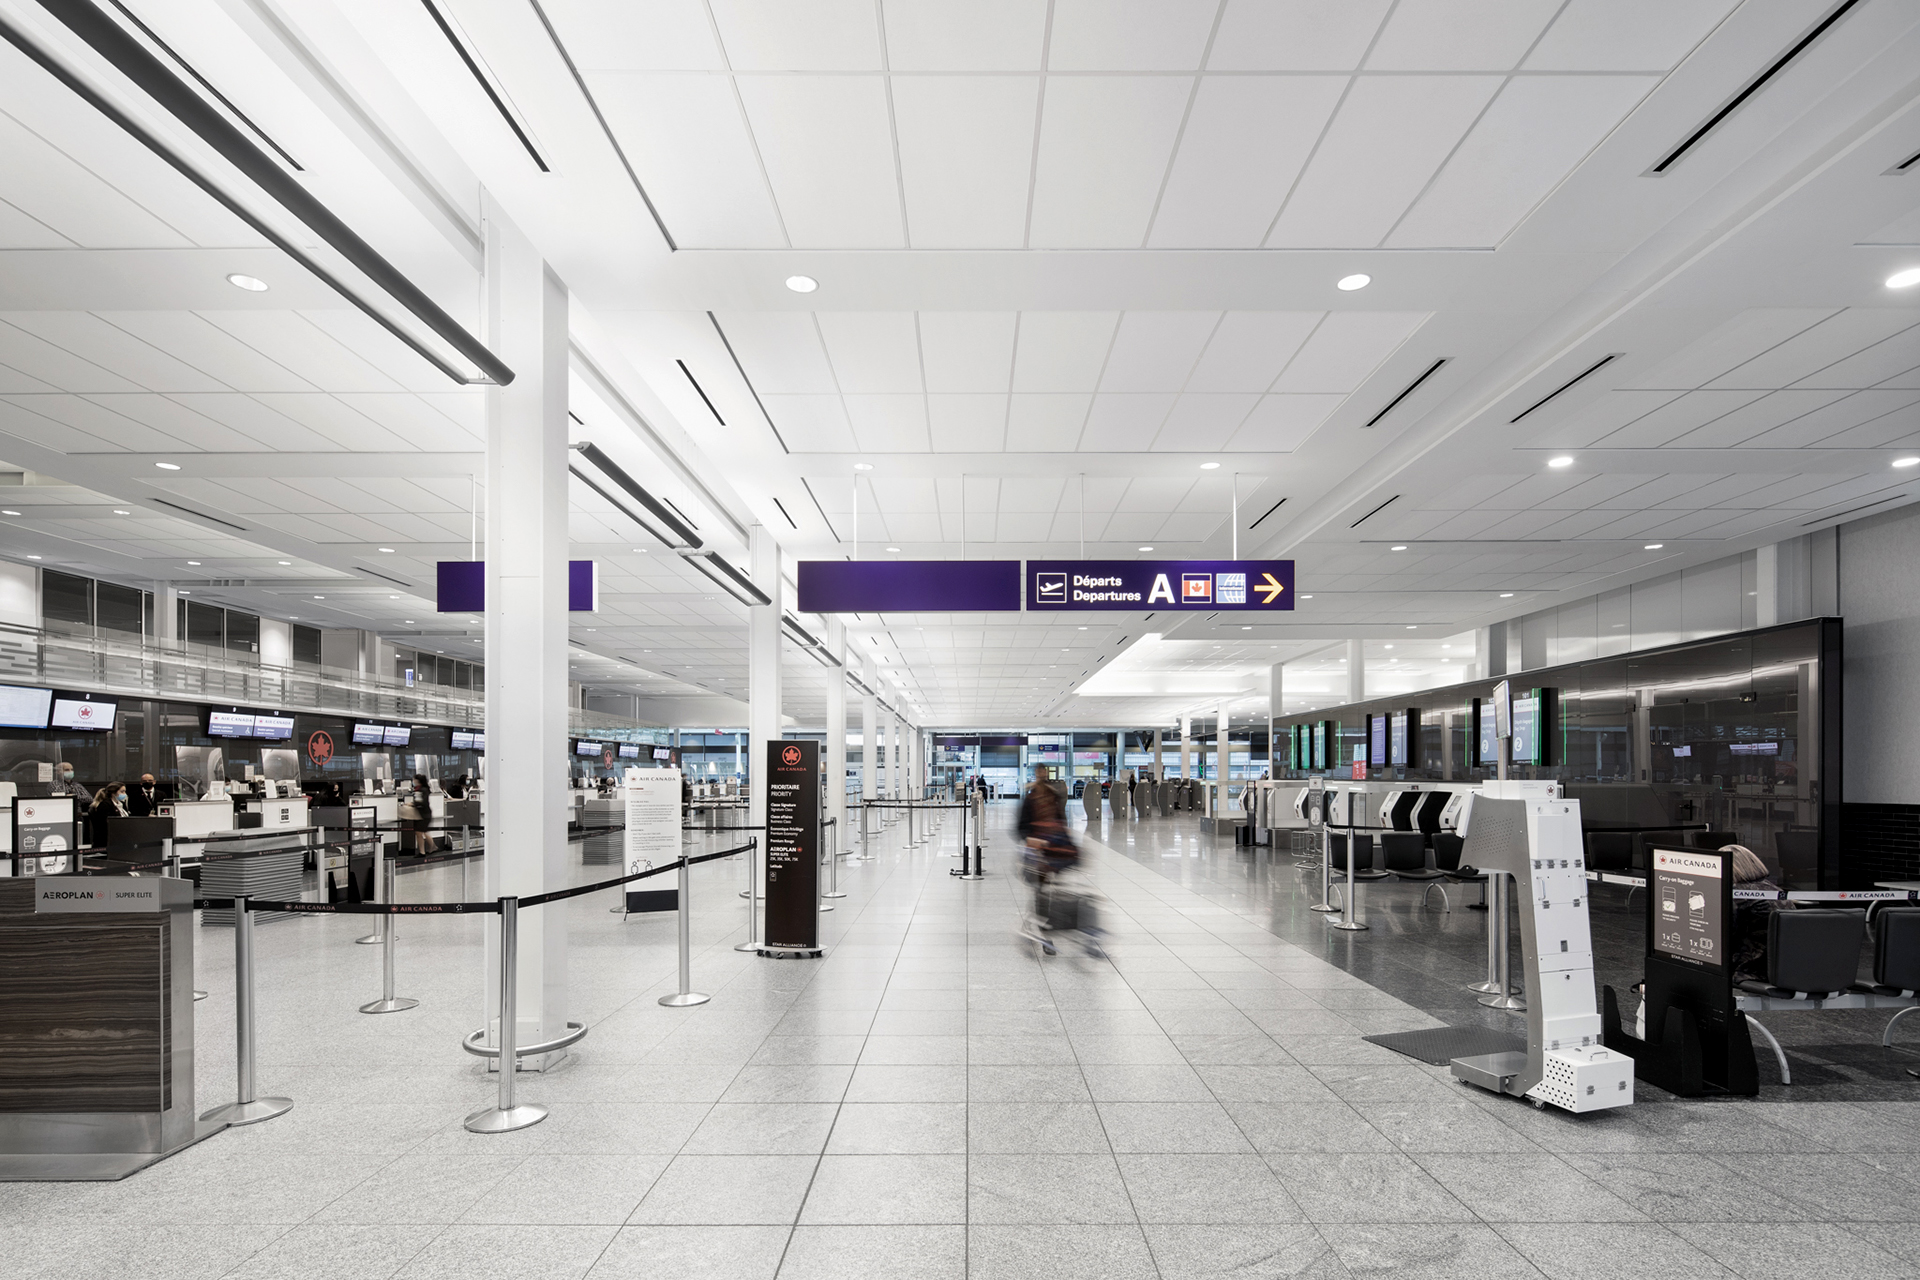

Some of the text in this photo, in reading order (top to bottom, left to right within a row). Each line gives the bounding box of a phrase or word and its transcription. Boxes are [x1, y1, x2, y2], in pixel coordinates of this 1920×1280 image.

[1073, 575, 1122, 588] Départs
[1147, 573, 1176, 604] A
[1073, 590, 1141, 603] Departures
[1683, 859, 1717, 869] CANADA
[1659, 875, 1695, 886] Carry-on Baggage
[43, 891, 94, 899] AEROPLAN
